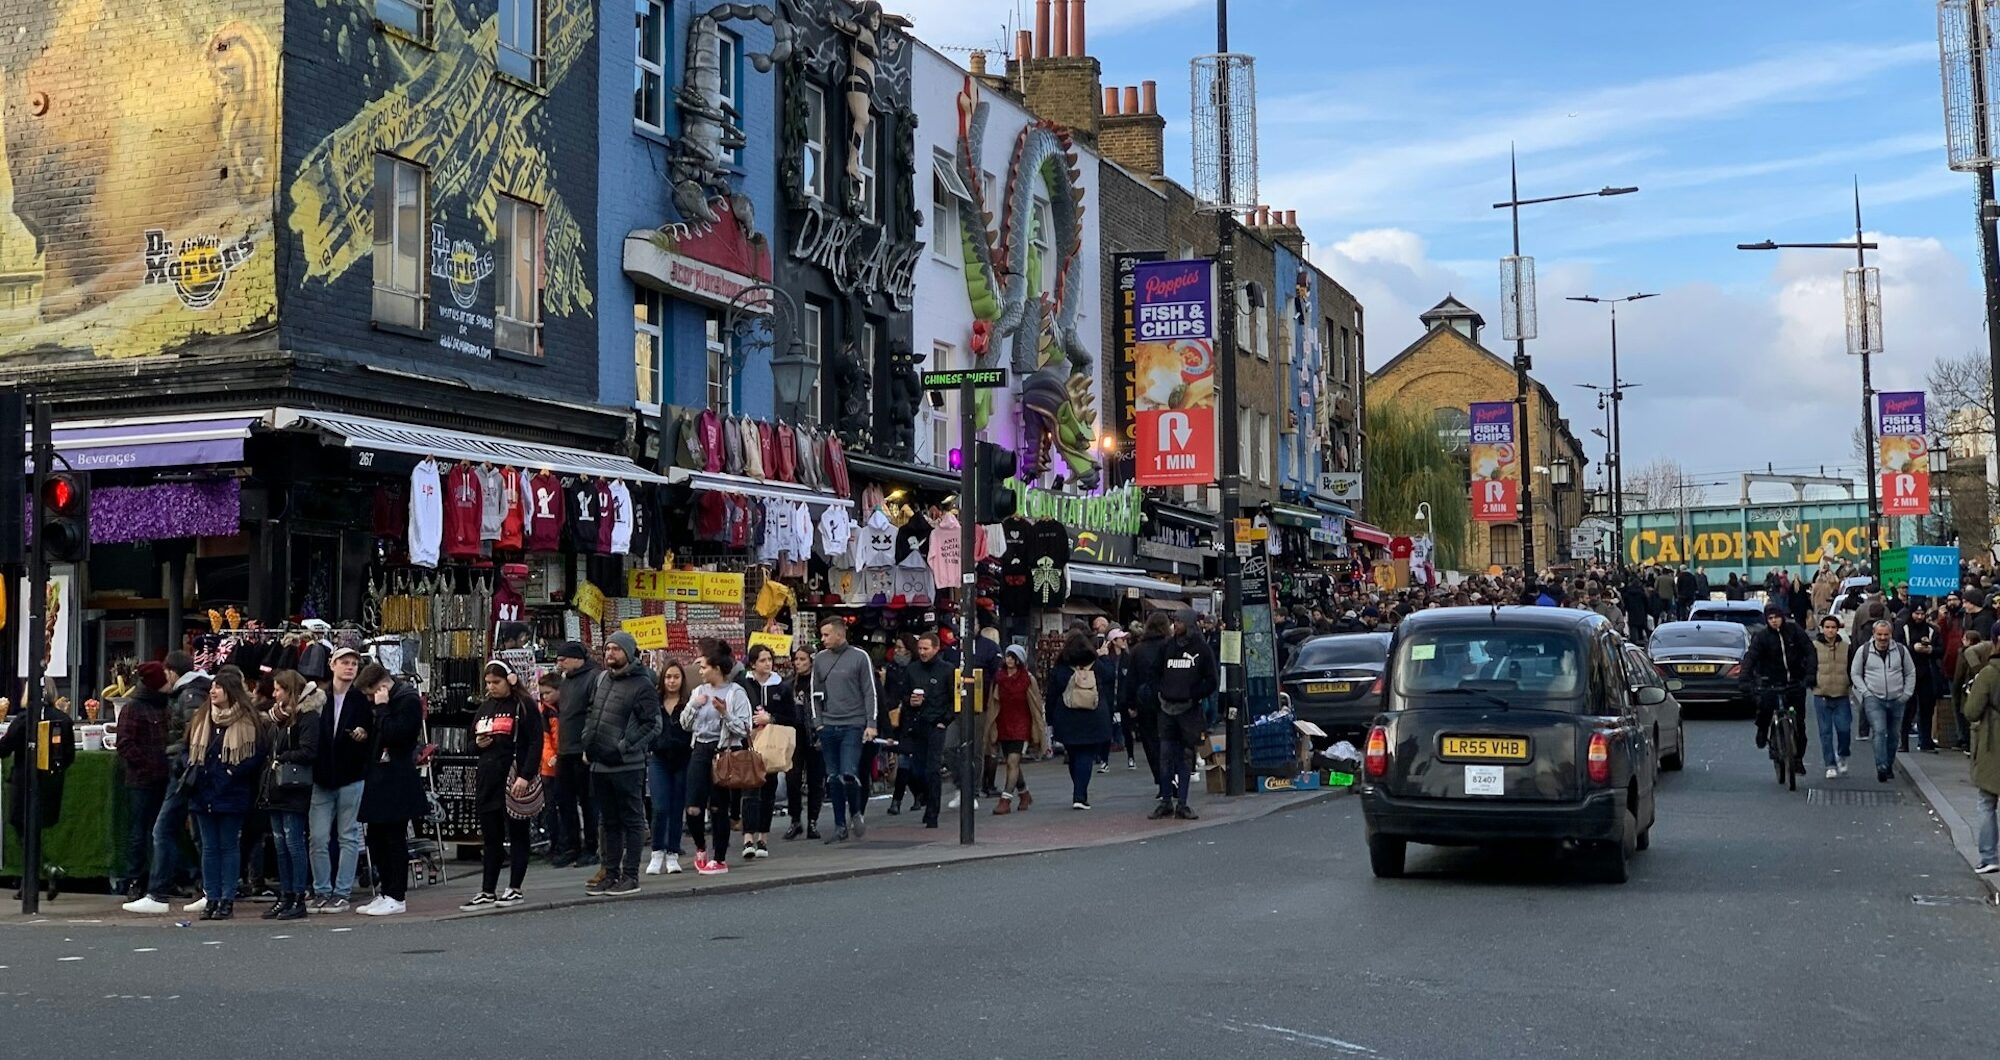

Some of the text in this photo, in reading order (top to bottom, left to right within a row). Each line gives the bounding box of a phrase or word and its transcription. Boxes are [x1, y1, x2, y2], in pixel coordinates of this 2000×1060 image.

[144, 235, 255, 285] Martens
[431, 248, 495, 280] Martens
[1146, 269, 1200, 302] Poppies
[1141, 304, 1205, 322] FISH &
[1141, 320, 1206, 337] CHIPS
[924, 372, 962, 385] CHINESE
[1882, 415, 1922, 425] FISH &
[1473, 424, 1511, 434] FISH &
[1882, 424, 1923, 433] CHIPS
[1474, 432, 1511, 442] CHIPS
[78, 452, 136, 466] Beverages
[358, 452, 375, 467] 267
[1153, 455, 1164, 470] 1
[1167, 454, 1196, 470] MIN
[1323, 480, 1357, 490] Martens
[1482, 503, 1507, 513] 2 MIN
[1892, 497, 1919, 507] 2 MIN
[1060, 497, 1082, 527] EAT
[1630, 529, 1780, 566] CAMDEN
[1911, 554, 1956, 566] MONEY
[634, 571, 658, 590] £1
[719, 577, 736, 585] each
[1908, 576, 1960, 588] CHANGE
[711, 588, 725, 596] for
[727, 589, 740, 597] £5
[635, 627, 662, 638] for £1
[1167, 658, 1192, 669] PUMA
[1449, 737, 1520, 754] LR55 VHB
[1472, 775, 1497, 784] 82407
